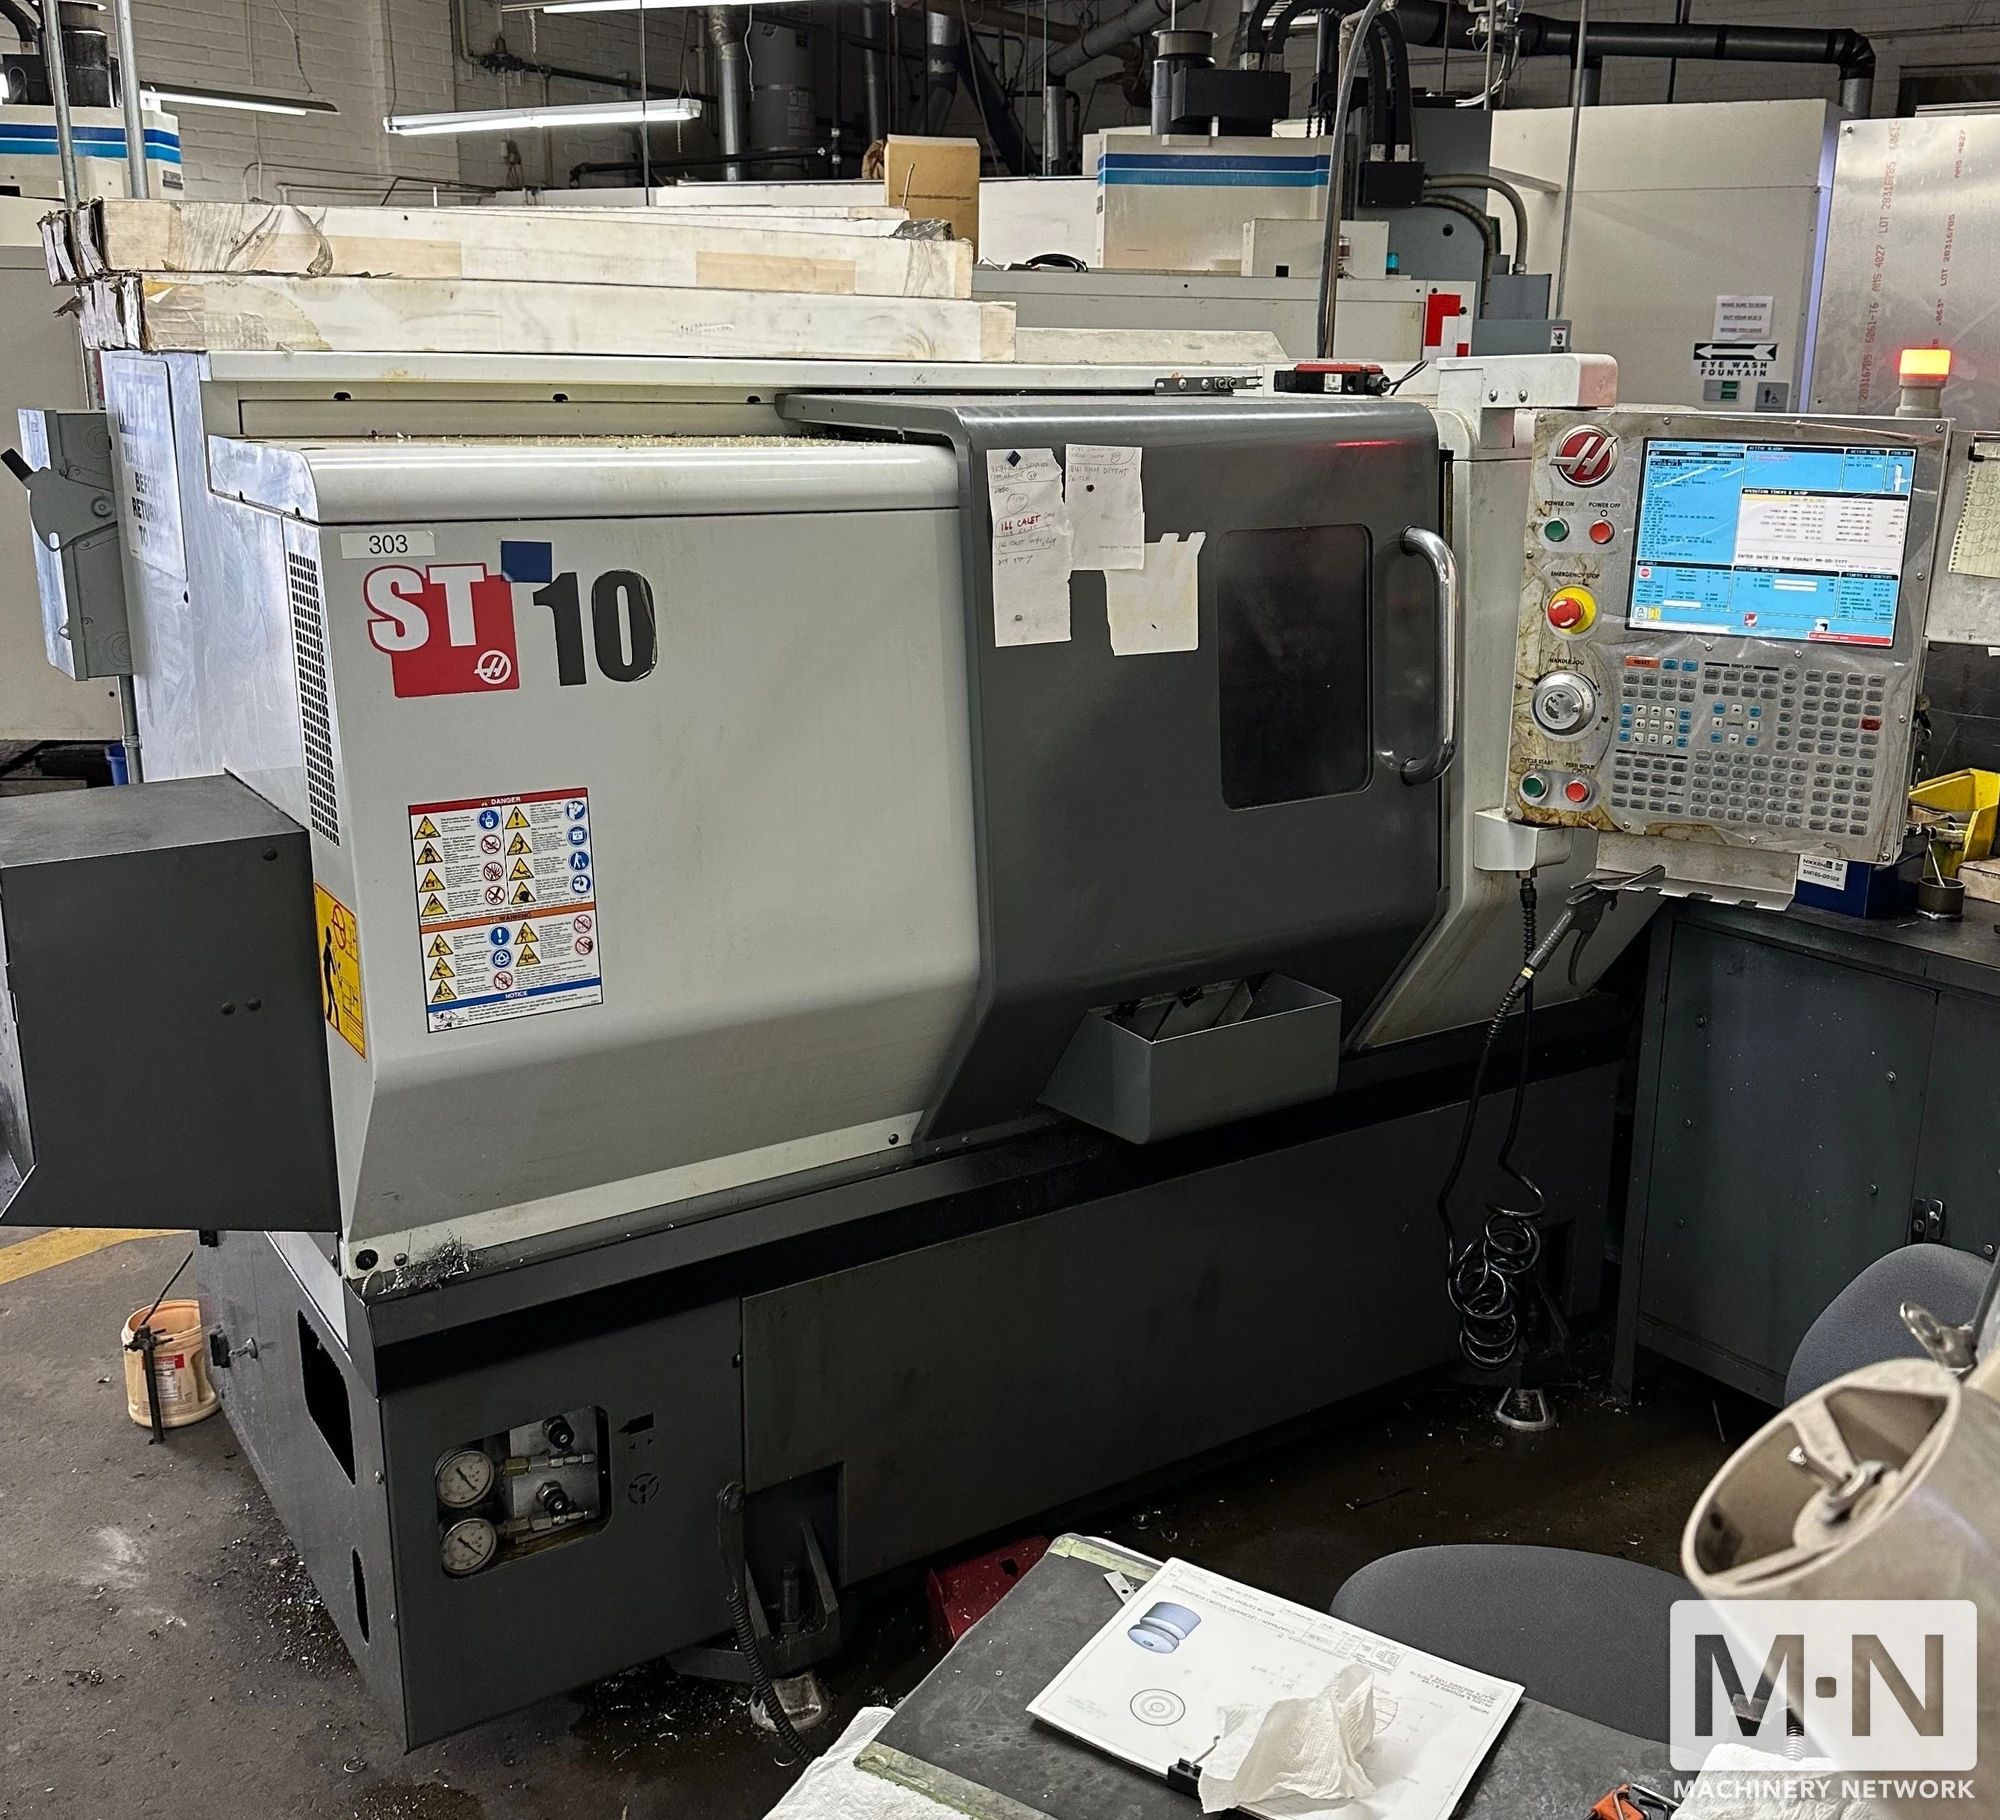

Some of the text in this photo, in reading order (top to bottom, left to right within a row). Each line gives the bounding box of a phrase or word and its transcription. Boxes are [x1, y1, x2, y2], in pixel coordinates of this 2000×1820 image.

[1878, 215, 1890, 234] LOT
[1875, 244, 1886, 269] 4027
[1872, 273, 1882, 292] AMS
[1940, 268, 1949, 287] LOT
[1865, 302, 1879, 344] 6061-T6
[1732, 361, 1767, 369] WASH
[1700, 369, 1767, 377] FOUNTAIN
[369, 534, 409, 555] 303
[1550, 570, 1584, 578] EMERGENCY
[364, 563, 657, 687] ST 10
[490, 796, 521, 805] DANGER
[1803, 859, 1826, 867] NIKKEN
[499, 912, 532, 922] WARNING
[504, 990, 528, 999] NOTICE
[1171, 1584, 1205, 1600] EQUIPMENT
[1205, 1598, 1228, 1609] STUDIO
[1234, 1597, 1257, 1610] DETENT
[1227, 1606, 1259, 1621] LEONARD
[1261, 1619, 1296, 1635] CHAPMAN
